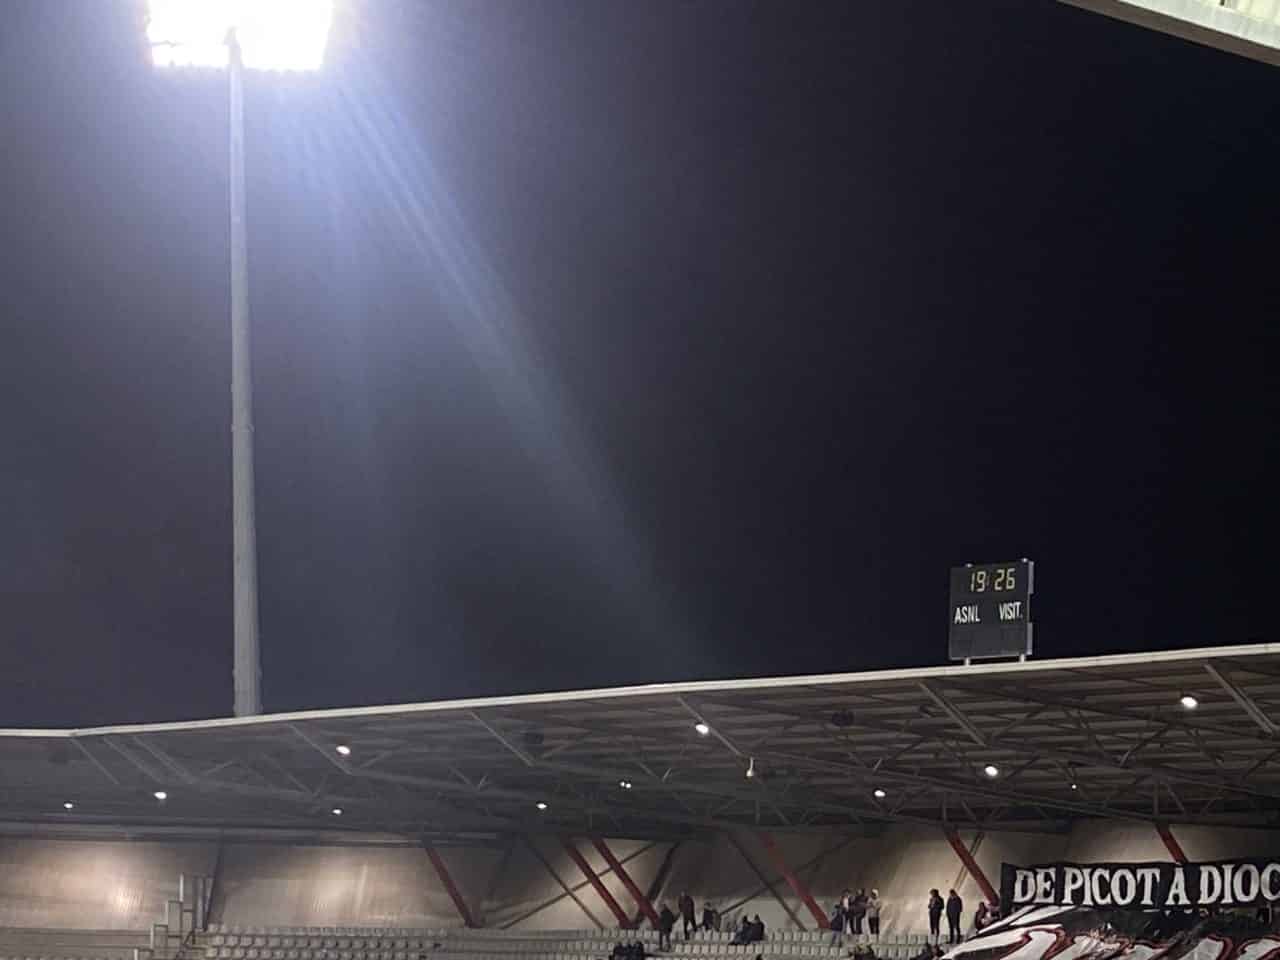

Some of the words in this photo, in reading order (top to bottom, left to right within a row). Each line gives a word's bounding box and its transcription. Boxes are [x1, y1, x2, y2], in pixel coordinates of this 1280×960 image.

[954, 605, 981, 625] ASNL
[1013, 868, 1055, 904] DE
[1064, 867, 1160, 905] PICOT
